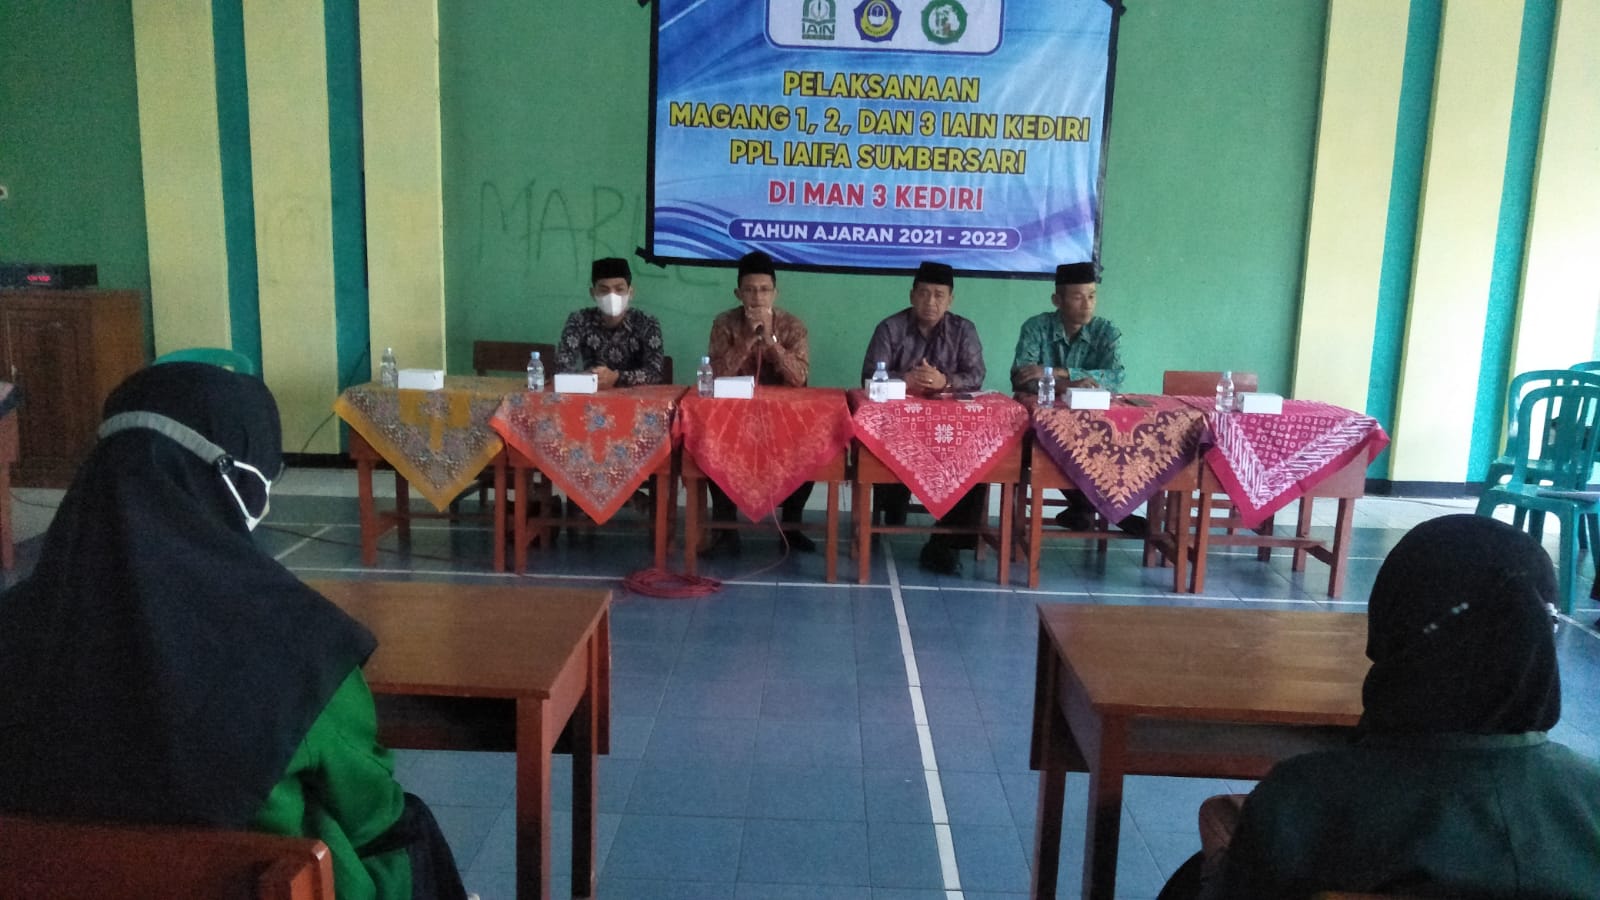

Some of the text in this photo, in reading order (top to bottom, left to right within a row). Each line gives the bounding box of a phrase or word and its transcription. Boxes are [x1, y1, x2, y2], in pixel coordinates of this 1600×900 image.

[783, 71, 980, 102] PELAKSANAAN
[669, 101, 1091, 142] MAGANG 1, 2, DAN 3 IAIN KEDIRI
[730, 139, 1027, 175] PPL IAIFA SUMBERSARI
[769, 180, 984, 211] DI MAN 3 KEDIRI
[742, 222, 808, 240] TAHUN
[813, 225, 893, 243] AJARAN
[899, 228, 943, 244] 2021
[960, 230, 1008, 247] 2022
